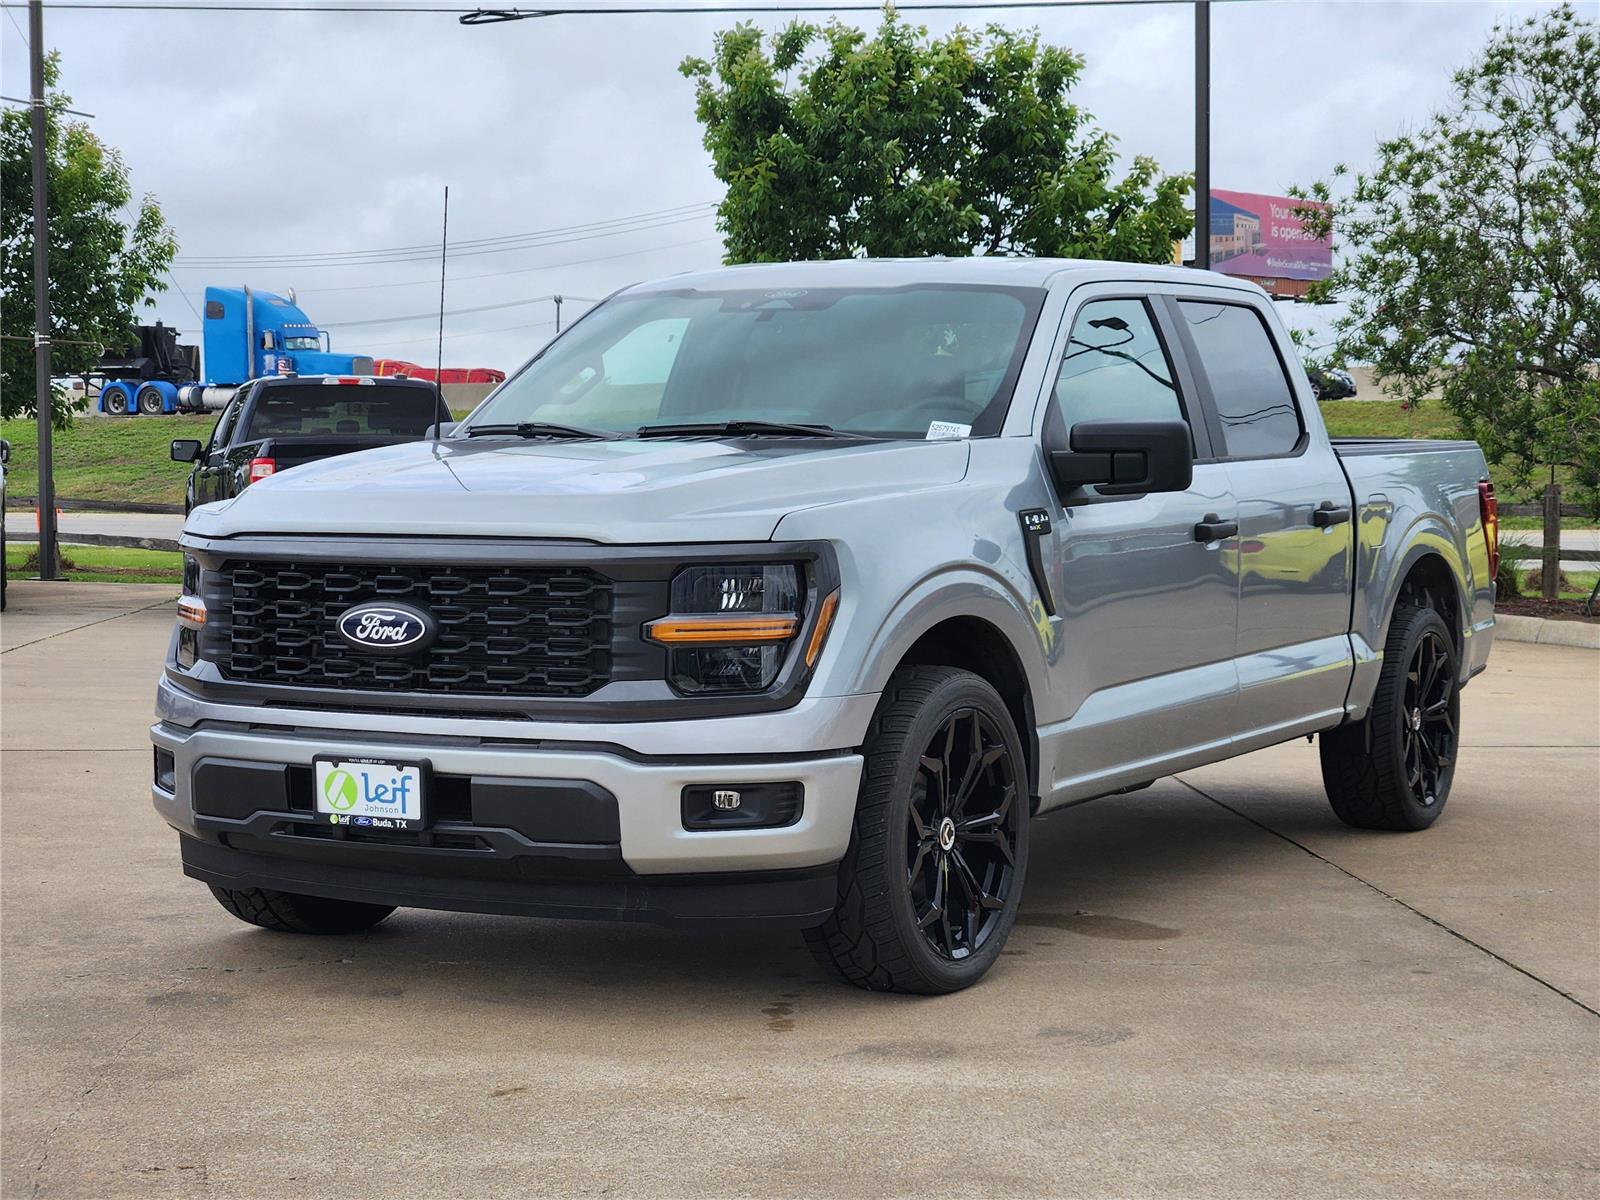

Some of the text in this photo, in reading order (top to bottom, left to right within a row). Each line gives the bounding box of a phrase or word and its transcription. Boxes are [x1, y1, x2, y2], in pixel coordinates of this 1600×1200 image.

[1270, 203, 1289, 219] Your
[1271, 221, 1279, 237] is
[1280, 227, 1302, 242] open
[356, 613, 409, 641] Ford
[364, 804, 399, 814] Johnson
[372, 818, 394, 828] Buda,
[395, 820, 408, 829] TX
